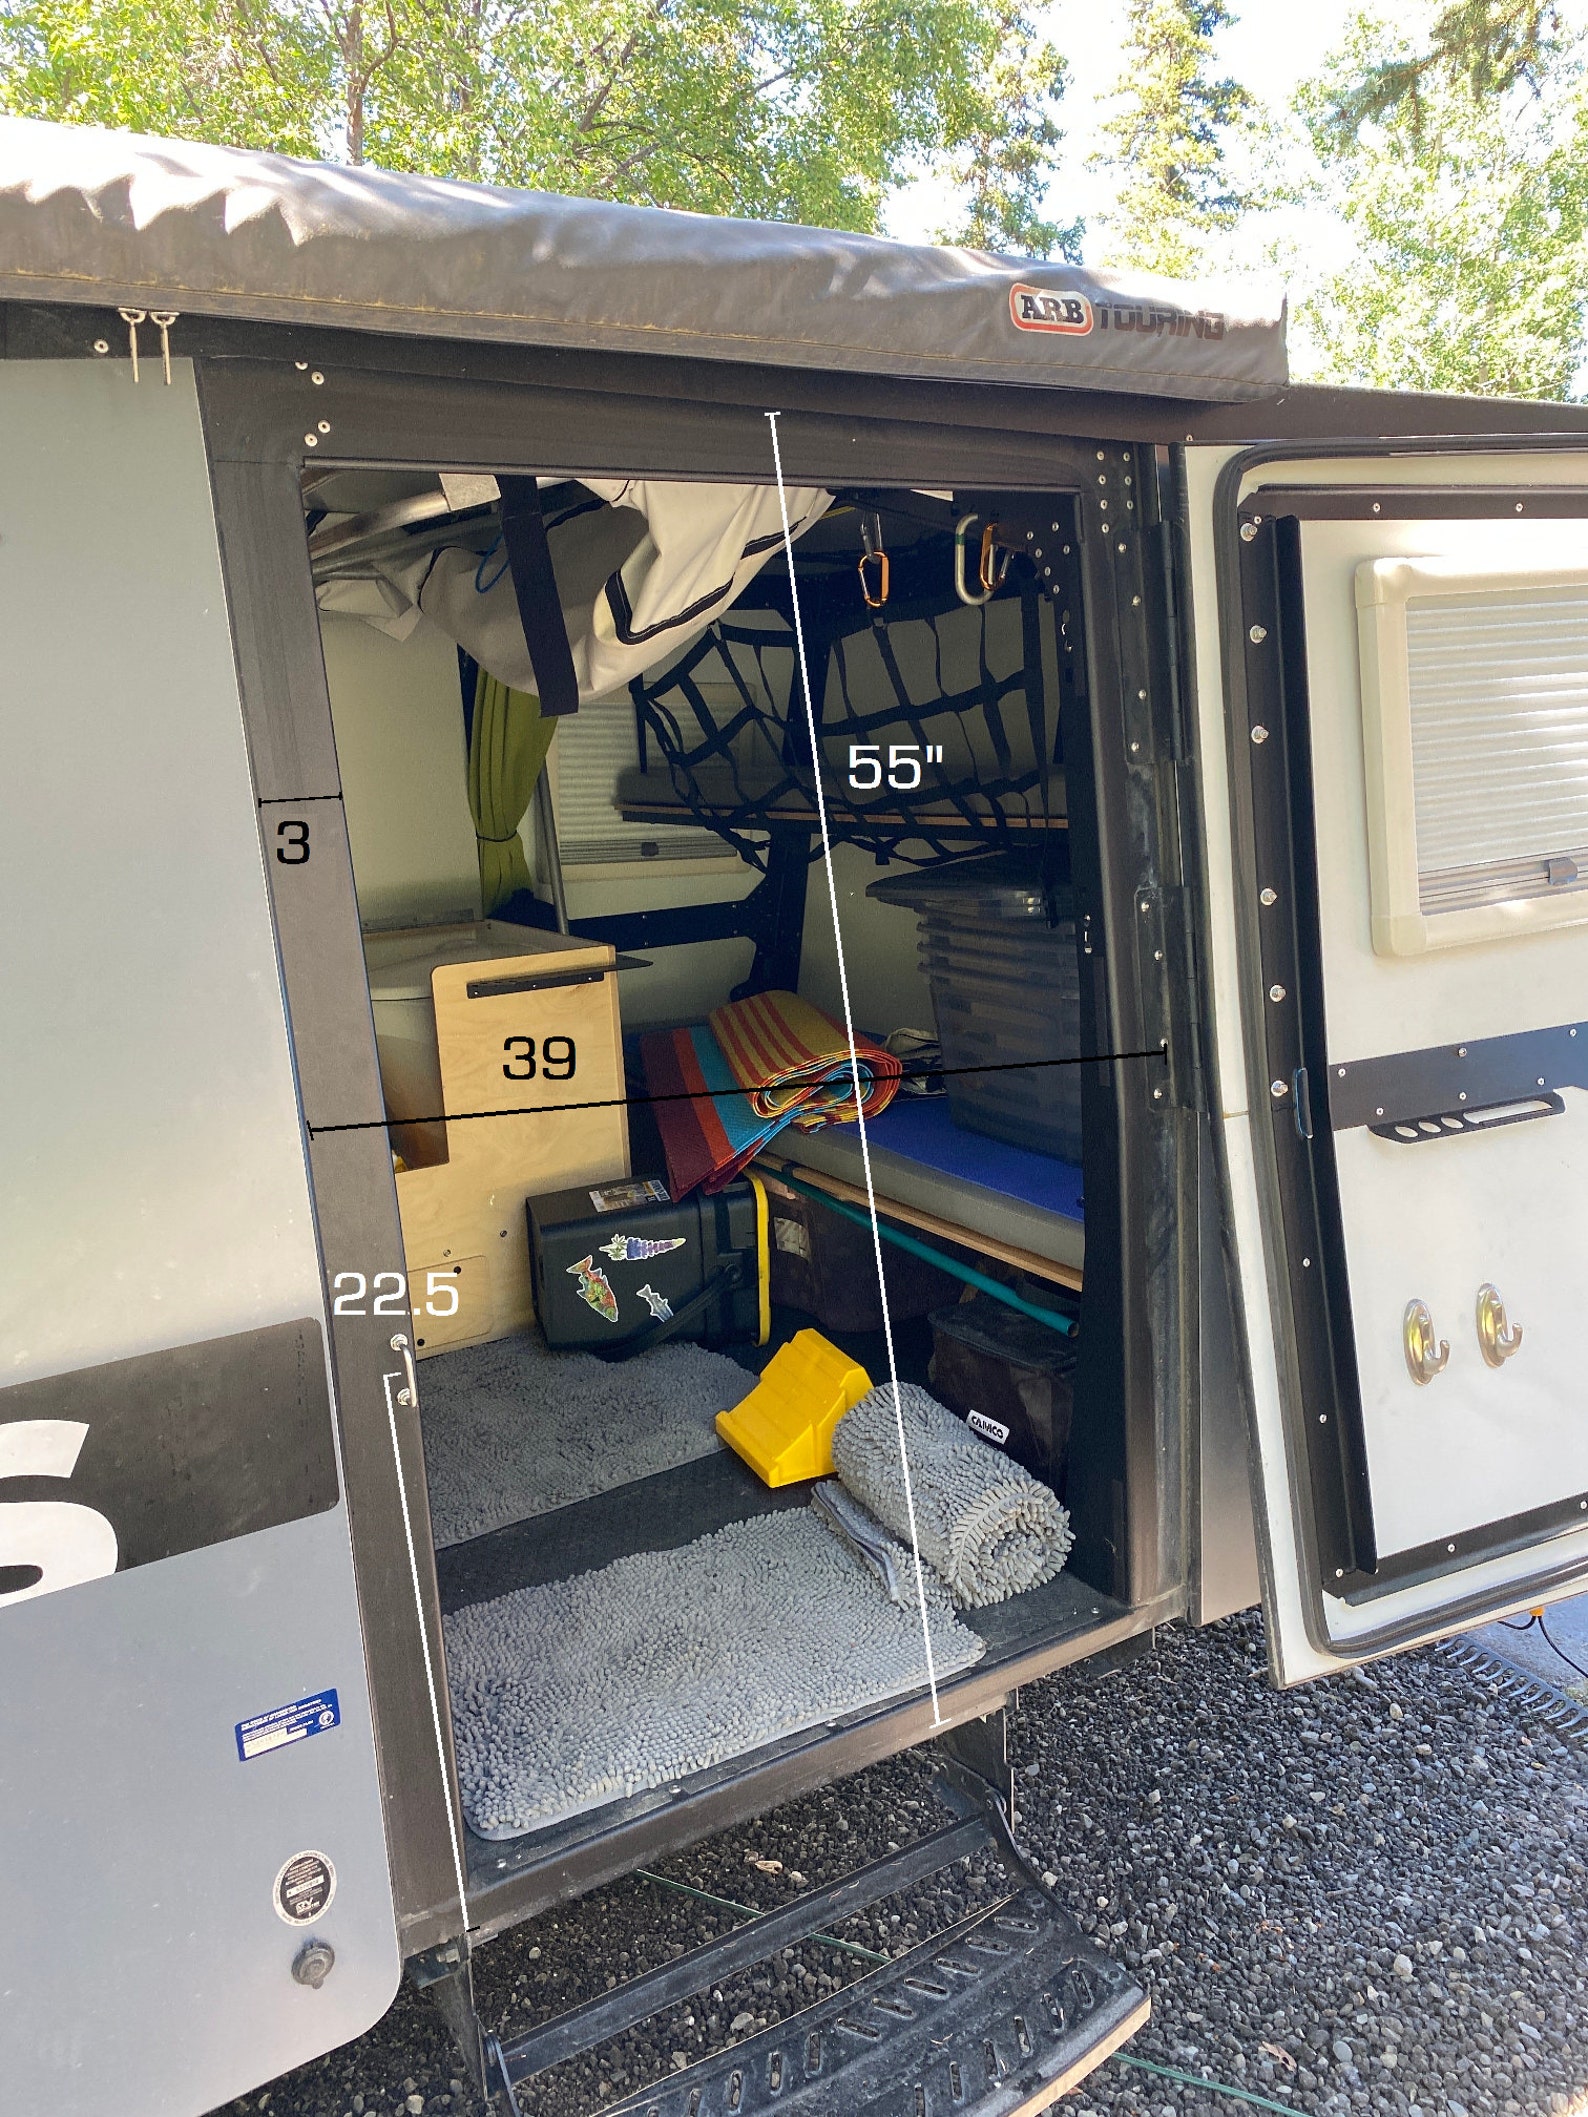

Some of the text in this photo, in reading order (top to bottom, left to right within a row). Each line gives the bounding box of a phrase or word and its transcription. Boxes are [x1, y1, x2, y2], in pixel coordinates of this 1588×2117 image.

[1021, 295, 1225, 341] ARB TOURING
[971, 1415, 1004, 1439] CAMCO
